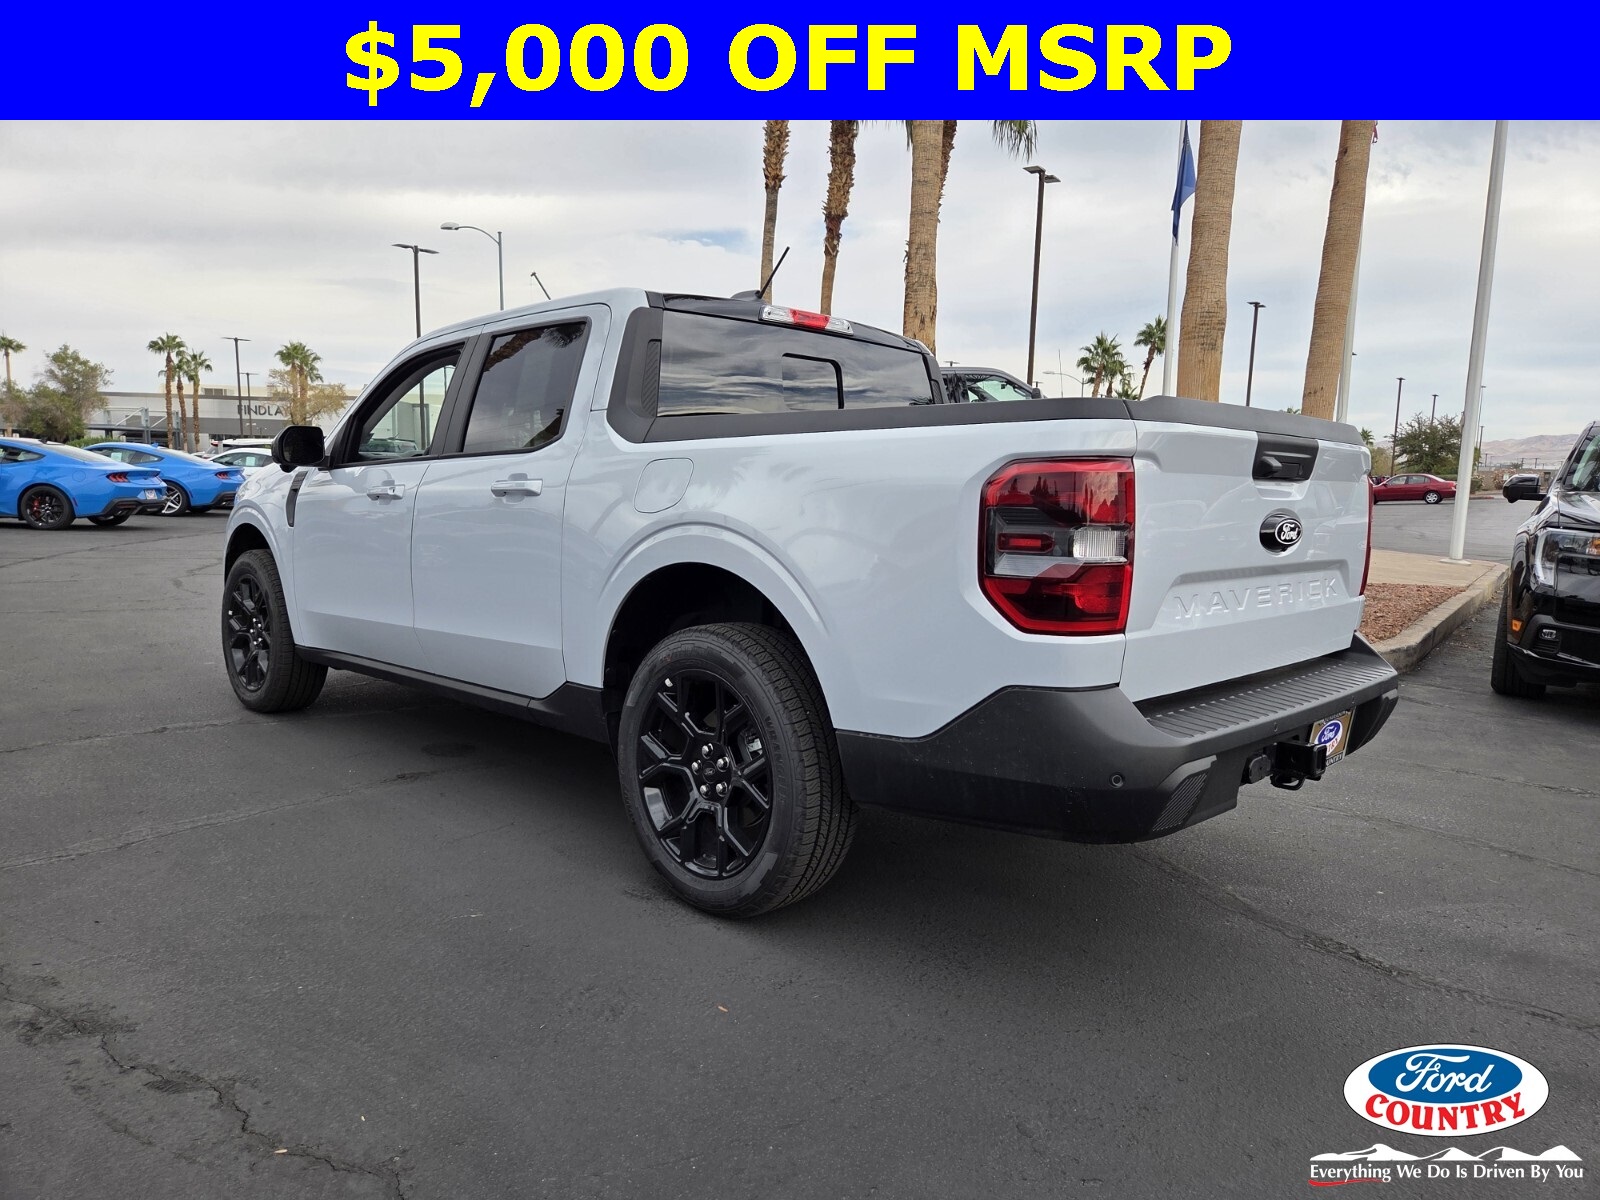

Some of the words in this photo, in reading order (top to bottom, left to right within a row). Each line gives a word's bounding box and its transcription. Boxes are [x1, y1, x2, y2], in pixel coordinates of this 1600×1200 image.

[237, 404, 287, 416] FINDLA
[1280, 523, 1299, 541] Ford
[1174, 577, 1338, 620] MAVERICK
[1321, 725, 1337, 743] Ford
